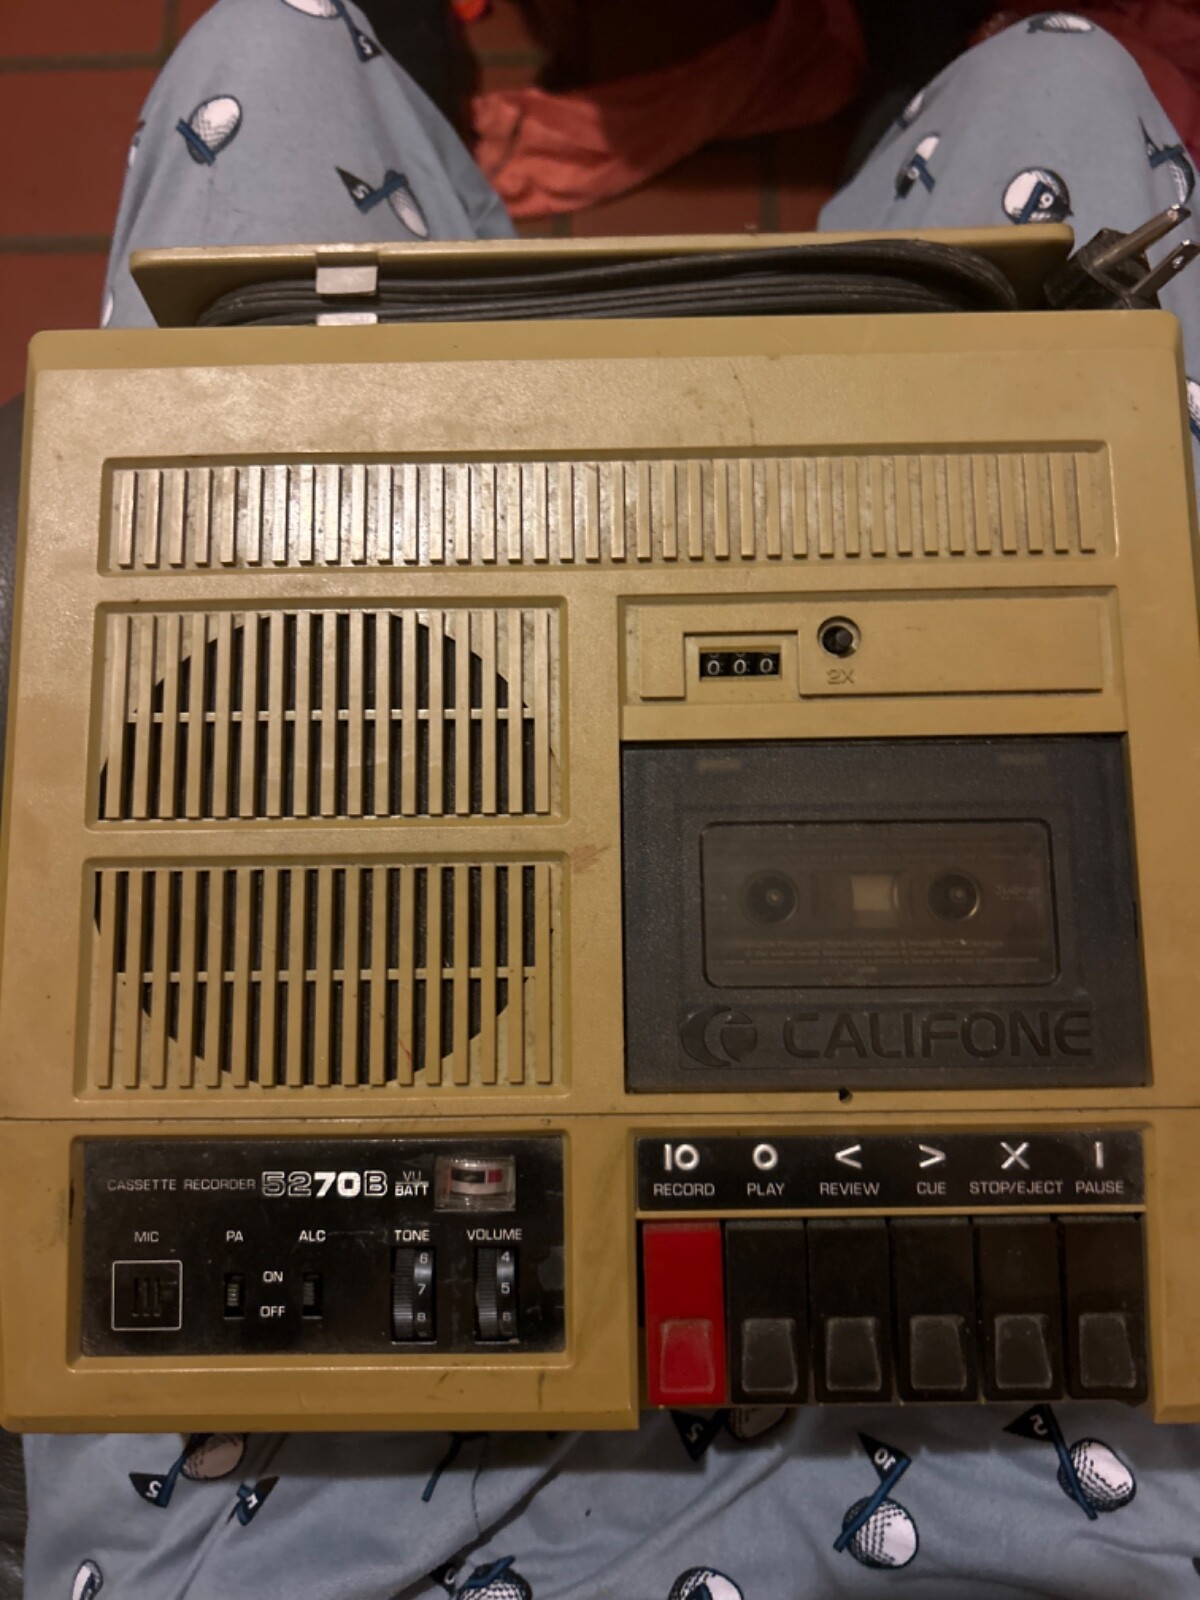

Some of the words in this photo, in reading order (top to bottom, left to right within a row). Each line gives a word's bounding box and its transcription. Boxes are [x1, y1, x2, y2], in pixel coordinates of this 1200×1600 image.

[782, 1010, 1093, 1060] CALIFONE
[107, 1178, 178, 1191] CASSETTE
[183, 1178, 257, 1190] RECORDER
[261, 1170, 388, 1198] 5270B
[394, 1182, 430, 1197] BATT
[653, 1182, 716, 1196] RECORD
[746, 1182, 786, 1196] PLAY
[819, 1181, 881, 1196] REVIEW
[916, 1181, 947, 1195] CUE
[969, 1180, 1064, 1195] STOP/EJECT
[1075, 1180, 1125, 1195] PAUSE
[133, 1230, 160, 1243] MIC
[225, 1229, 245, 1243] PA
[298, 1229, 327, 1242] ALC
[394, 1229, 431, 1242] TONE
[466, 1228, 523, 1241] VOLUME
[419, 1252, 430, 1265] 6
[500, 1251, 511, 1263] 4
[262, 1270, 284, 1283] ON
[417, 1283, 427, 1296] 7
[500, 1281, 511, 1295] 5
[259, 1305, 286, 1318] OFF
